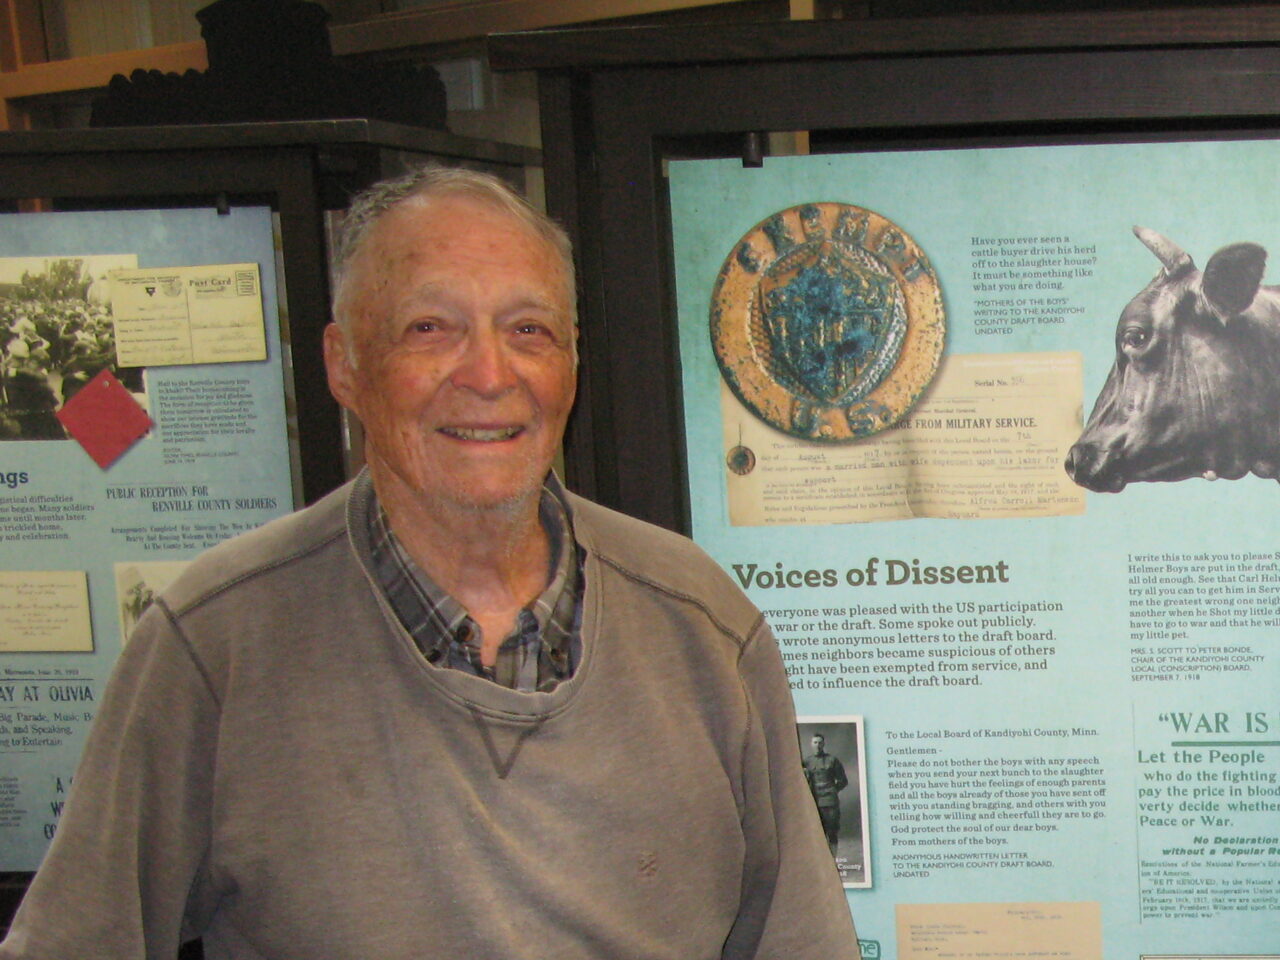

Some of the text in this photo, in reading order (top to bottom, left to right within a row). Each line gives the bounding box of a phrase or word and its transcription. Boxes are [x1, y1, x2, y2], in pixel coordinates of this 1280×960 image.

[971, 237, 995, 246] Have
[998, 238, 1015, 246] you
[971, 245, 1096, 258] cattle buyer drive his herd
[972, 259, 987, 268] off
[1000, 259, 1014, 268] the
[1017, 259, 1062, 268] slaughter
[1064, 257, 1097, 266] house?
[190, 279, 208, 287] Post
[211, 278, 231, 286] Card
[915, 418, 1037, 429] FROM MILITARY SERVICE.
[106, 486, 208, 499] PUBLIC RECEPTION FOR
[38, 505, 61, 514] Many
[152, 498, 277, 512] RENVILLE COUNTY SOLDIERS
[14, 514, 33, 522] until
[1128, 554, 1132, 562] I
[1135, 553, 1160, 562] write
[1162, 553, 1180, 562] this
[1193, 553, 1209, 561] ask
[1211, 553, 1229, 563] you
[1231, 553, 1241, 561] to
[1242, 552, 1272, 562] please
[732, 558, 1010, 589] Voices of Dissent
[822, 607, 846, 617] was
[849, 604, 897, 618] pleased
[900, 603, 929, 615] with
[932, 603, 953, 614] the
[956, 602, 975, 613] US
[978, 601, 1063, 615] participation
[775, 616, 1036, 633] war or the draft. Some spoke out publicly.
[783, 629, 1057, 648] wrote anonymous letters to the draft board.
[811, 648, 874, 663] neighbors
[877, 647, 925, 659] became
[928, 646, 995, 660] suspicious
[999, 645, 1012, 656] of
[1015, 644, 1056, 656] others
[807, 663, 837, 675] have
[840, 663, 870, 674] been
[873, 661, 936, 677] exempted
[938, 660, 969, 671] from
[972, 660, 1021, 673] service,
[1024, 659, 1048, 670] and
[807, 678, 820, 689] to
[822, 676, 882, 688] influence
[885, 676, 905, 687] the
[908, 675, 940, 686] draft
[942, 674, 982, 686] board.
[24, 686, 40, 701] AT
[50, 686, 94, 701] OLIVIA
[17, 712, 48, 722] Parade,
[1158, 712, 1230, 733] “WAR
[1246, 712, 1269, 733] IS
[13, 726, 28, 734] and
[886, 728, 1099, 740] To the Local Board of Kandiyohi County, Minn.
[12, 738, 20, 746] to
[887, 746, 937, 755] Gentlemen
[1138, 750, 1265, 766] Let the People
[1144, 771, 1172, 781] who
[1177, 771, 1192, 781] do
[1197, 771, 1218, 781] the
[1222, 770, 1276, 784] fighting
[1138, 788, 1162, 799] pay
[1167, 786, 1188, 797] the
[1193, 786, 1225, 799] price
[1229, 786, 1242, 796] in
[1139, 802, 1174, 813] verty
[1179, 801, 1220, 812] decide
[1140, 816, 1234, 826] Peace or War.
[1194, 836, 1209, 844] No
[1214, 836, 1278, 844] Declaration
[1162, 847, 1204, 856] without
[1222, 847, 1265, 856] Popular
